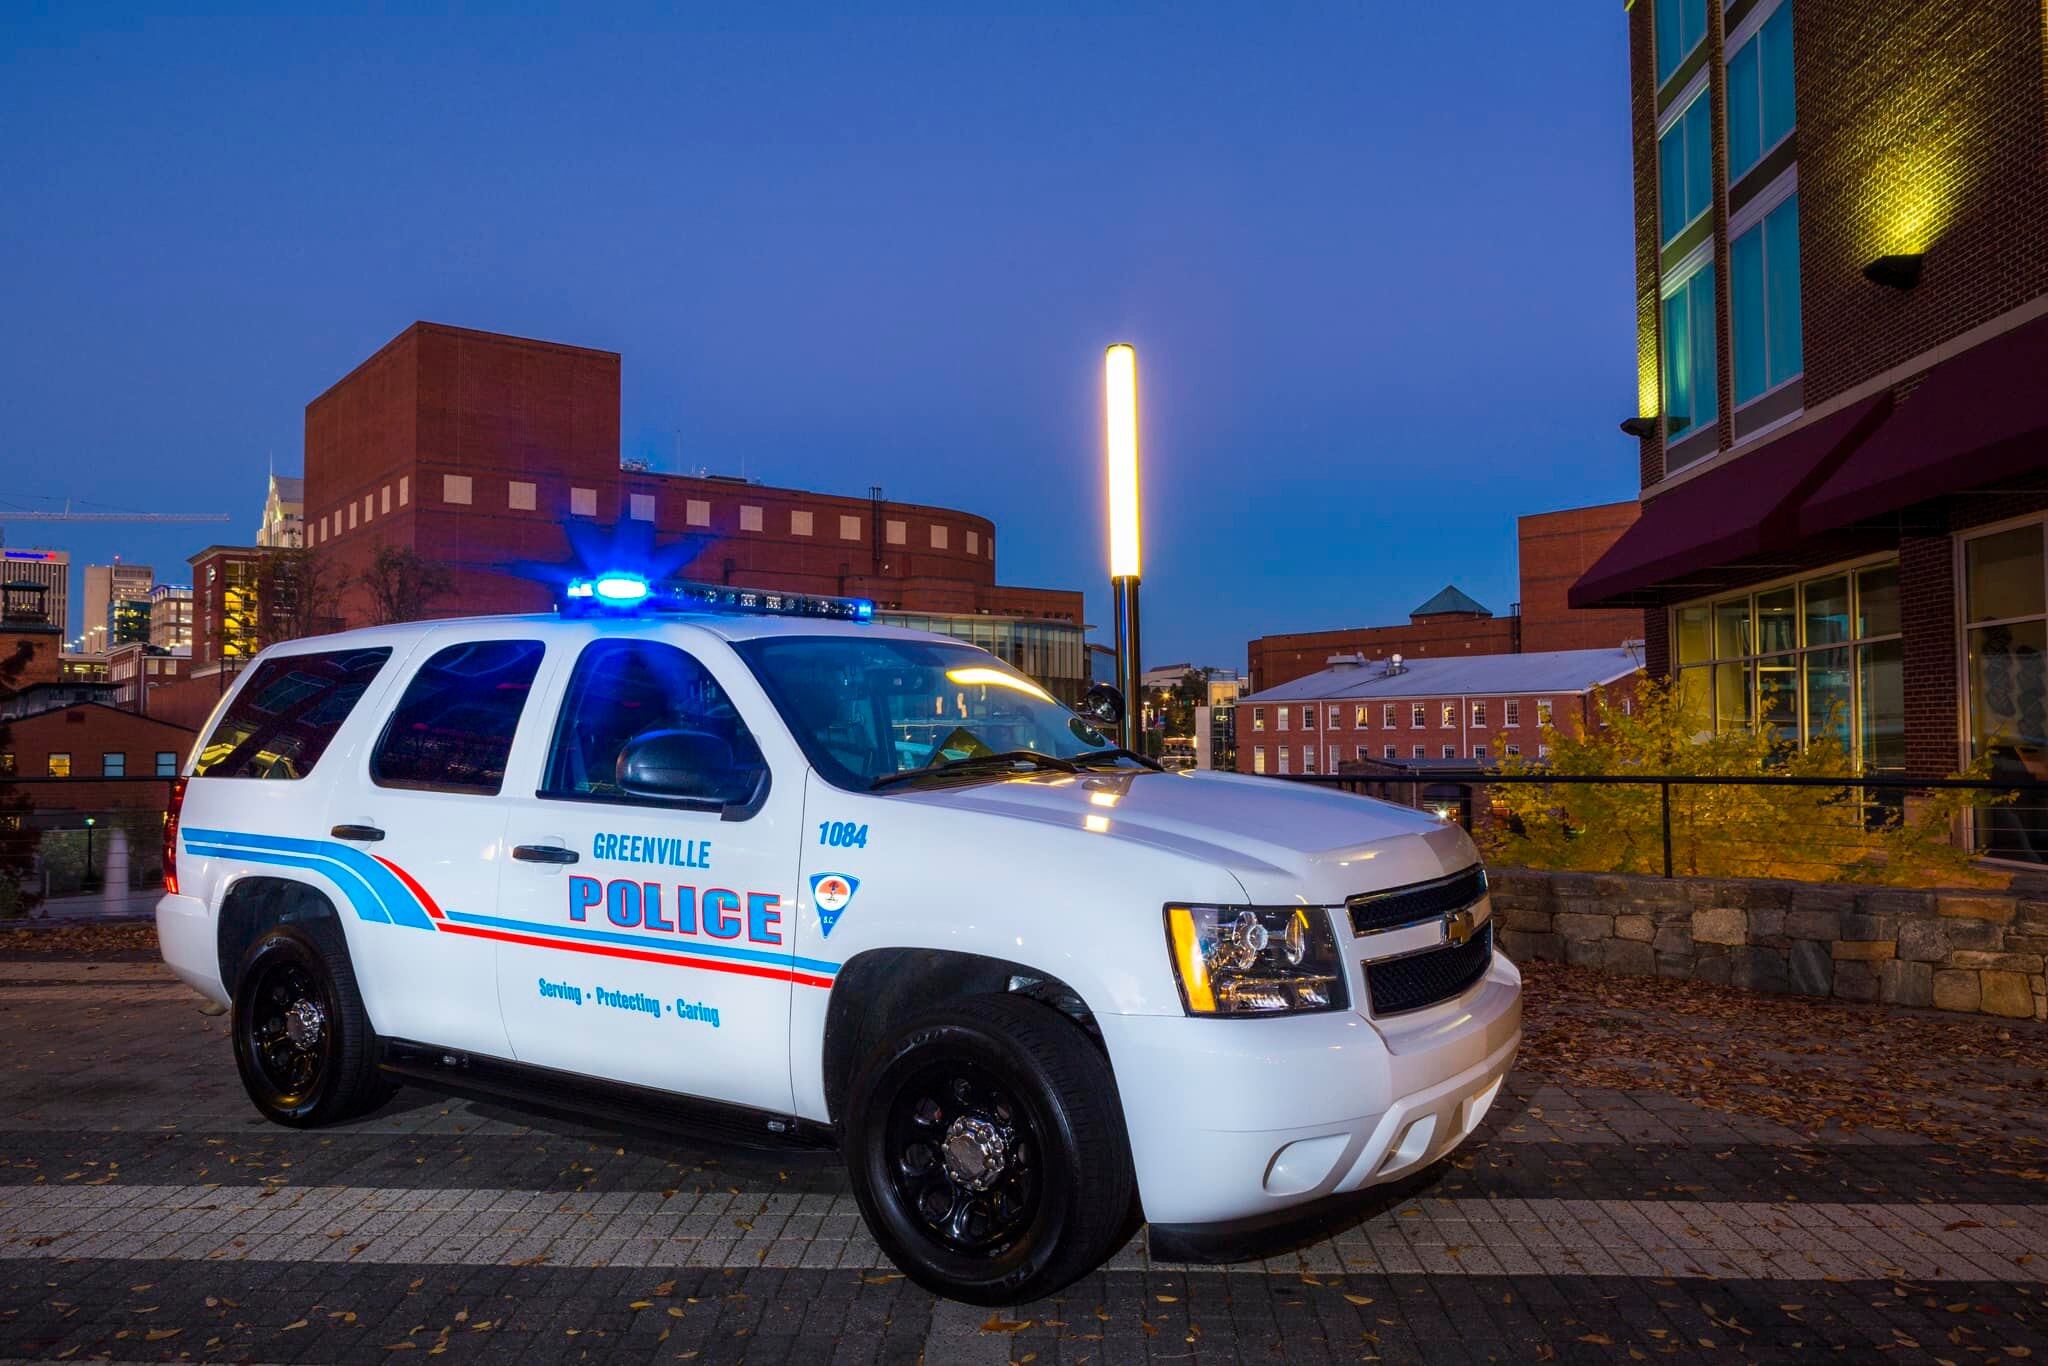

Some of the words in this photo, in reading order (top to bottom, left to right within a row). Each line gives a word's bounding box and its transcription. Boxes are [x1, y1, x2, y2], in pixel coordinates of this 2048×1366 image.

[593, 832, 711, 869] GREENVILLE
[818, 821, 869, 848] 1084
[569, 875, 782, 945] POLICE
[538, 978, 582, 1006] Serving
[595, 986, 661, 1019] Protecting
[675, 998, 720, 1028] Caring
